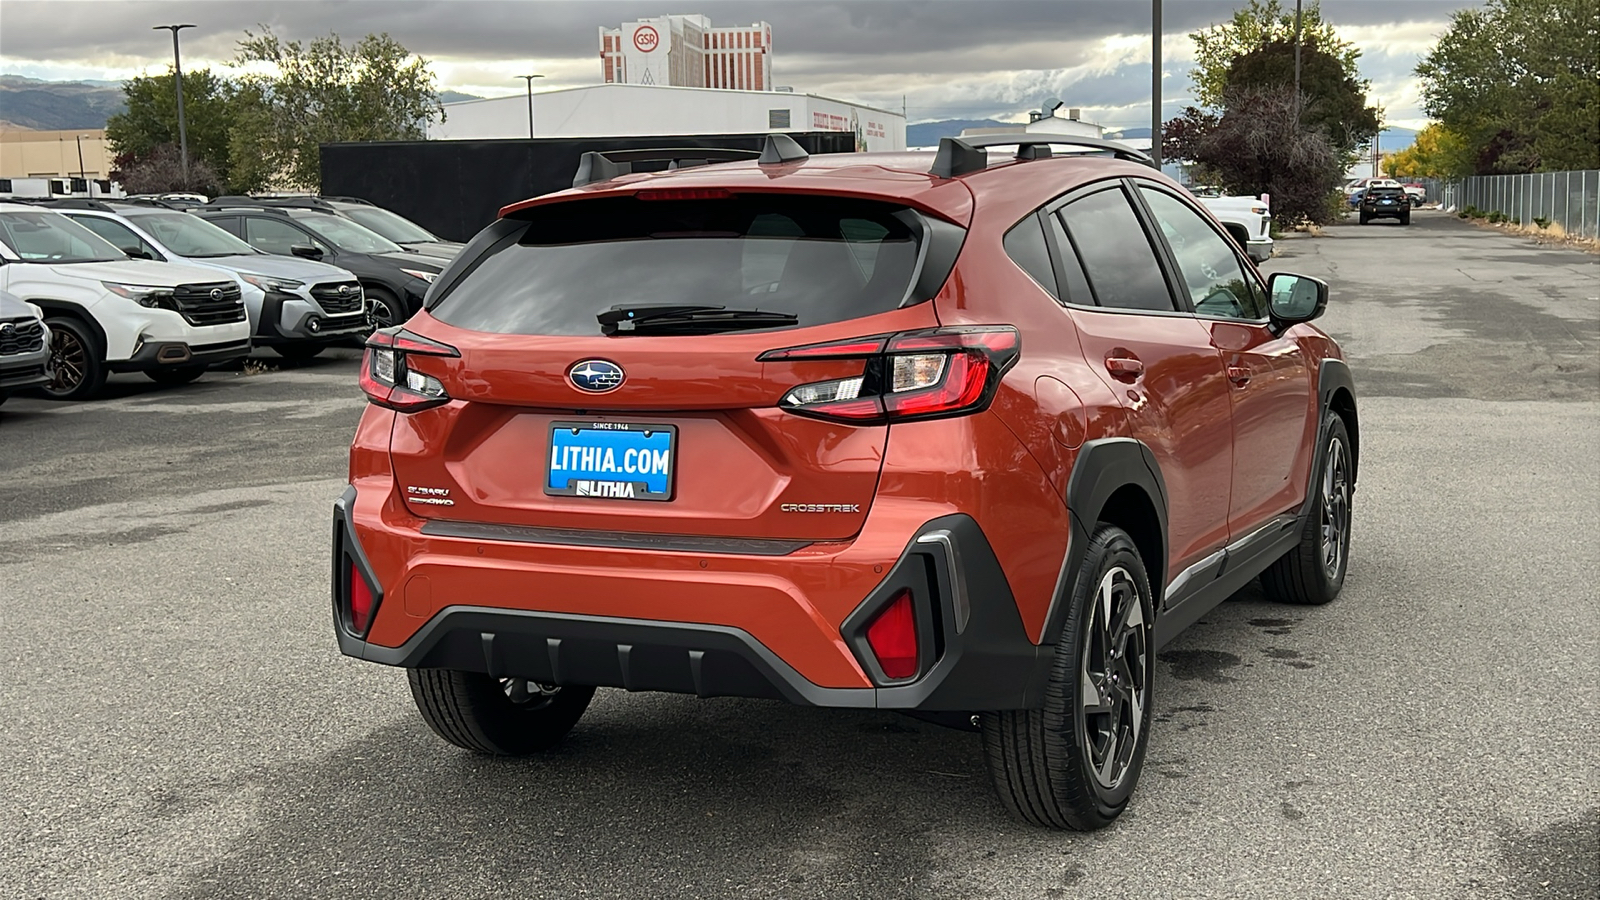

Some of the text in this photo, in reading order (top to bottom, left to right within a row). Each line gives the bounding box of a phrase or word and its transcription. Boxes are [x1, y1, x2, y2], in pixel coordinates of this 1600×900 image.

[636, 33, 656, 45] GSR
[593, 422, 629, 431] SINCE 1946
[551, 445, 670, 475] LITHIA.COM
[589, 480, 635, 498] LITHIA
[780, 503, 860, 513] CROSSTREK
